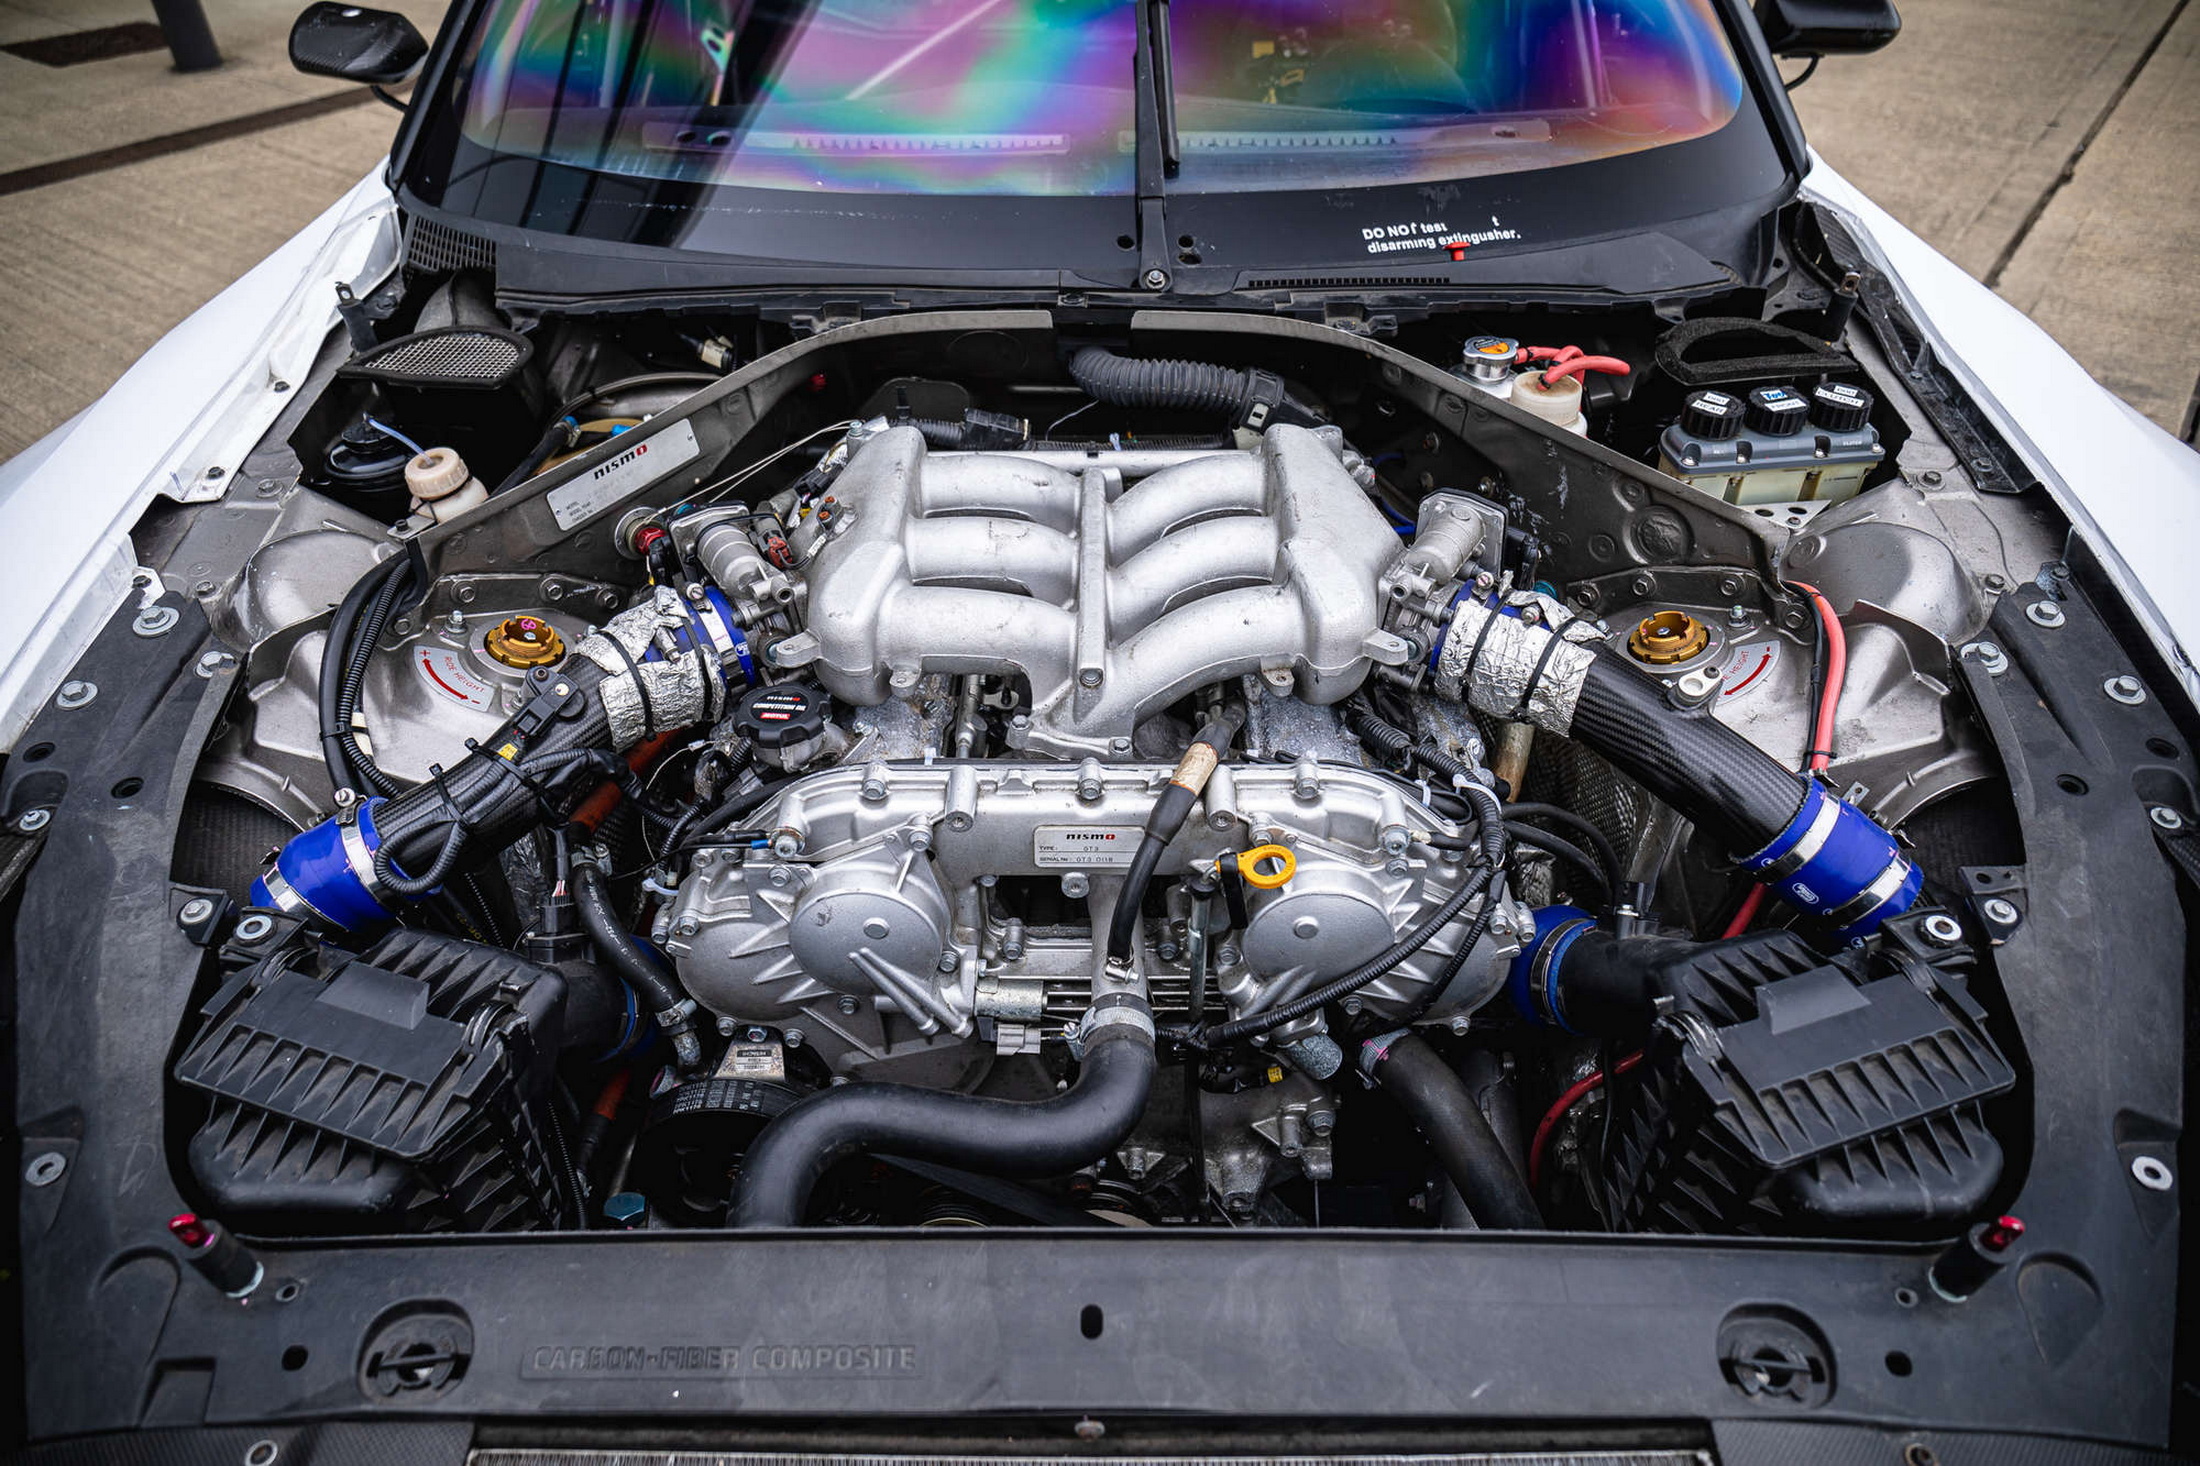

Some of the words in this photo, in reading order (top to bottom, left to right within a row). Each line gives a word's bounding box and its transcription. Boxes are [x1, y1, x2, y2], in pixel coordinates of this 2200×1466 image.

[1362, 227, 1385, 240] DO
[1367, 236, 1436, 254] disarming
[531, 1344, 740, 1372] CARBON-FIBER
[752, 1344, 917, 1372] COMPOSITE
